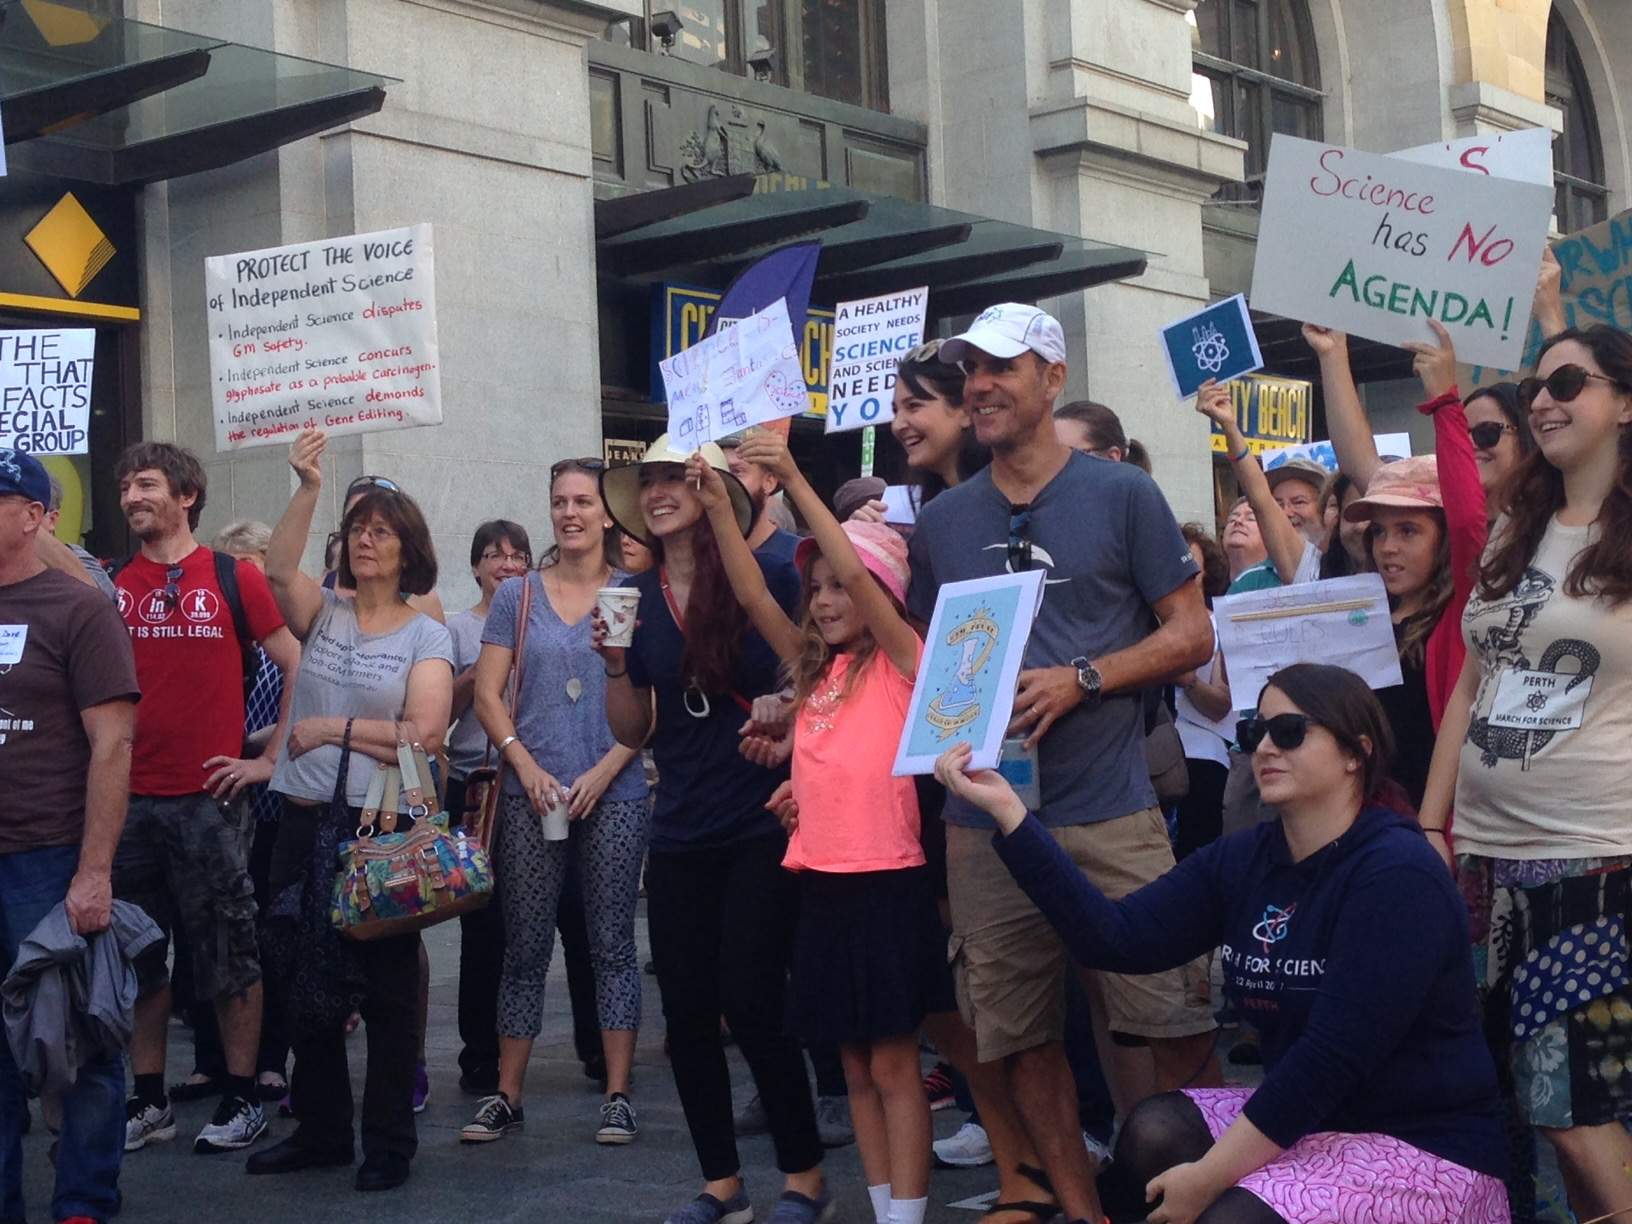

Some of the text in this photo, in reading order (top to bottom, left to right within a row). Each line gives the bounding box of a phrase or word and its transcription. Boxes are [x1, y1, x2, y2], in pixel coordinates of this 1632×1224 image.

[1310, 150, 1435, 214] Science
[1372, 212, 1428, 256] has
[237, 239, 414, 283] PROTECT THE VOICE
[209, 267, 414, 312] of Independent Science
[228, 297, 423, 341] Independent Science disputes
[839, 293, 923, 321] A HEALTHY
[836, 314, 921, 338] SOCIETY NEEDS
[0, 334, 61, 361] THE
[835, 333, 919, 362] SCIENCE
[14, 358, 94, 385] THAT
[228, 361, 300, 383] Independent
[305, 356, 348, 370] Science
[833, 357, 901, 379] AND SCIEN
[3, 385, 88, 410] FACTS
[226, 382, 281, 403] glyphosate
[289, 380, 304, 390] as
[309, 378, 319, 388] a
[323, 369, 367, 390] probable
[832, 373, 898, 400] NEED
[228, 386, 425, 425] Independent Science demands
[832, 397, 881, 427] YO
[1257, 383, 1307, 441] BEACH
[0, 409, 75, 433] ECIAL
[228, 430, 247, 442] the
[252, 422, 300, 438] regulation
[303, 417, 318, 429] of
[325, 414, 355, 427] Gene
[13, 430, 85, 452] GROUP
[149, 597, 165, 613] In
[195, 596, 206, 612] K
[137, 626, 149, 638] IS
[152, 625, 184, 638] STILL
[188, 625, 224, 638] LEGAL
[1523, 675, 1556, 688] PERTH
[1496, 713, 1572, 726] MARCH FOR SCIENCE
[1245, 955, 1271, 973] FOR
